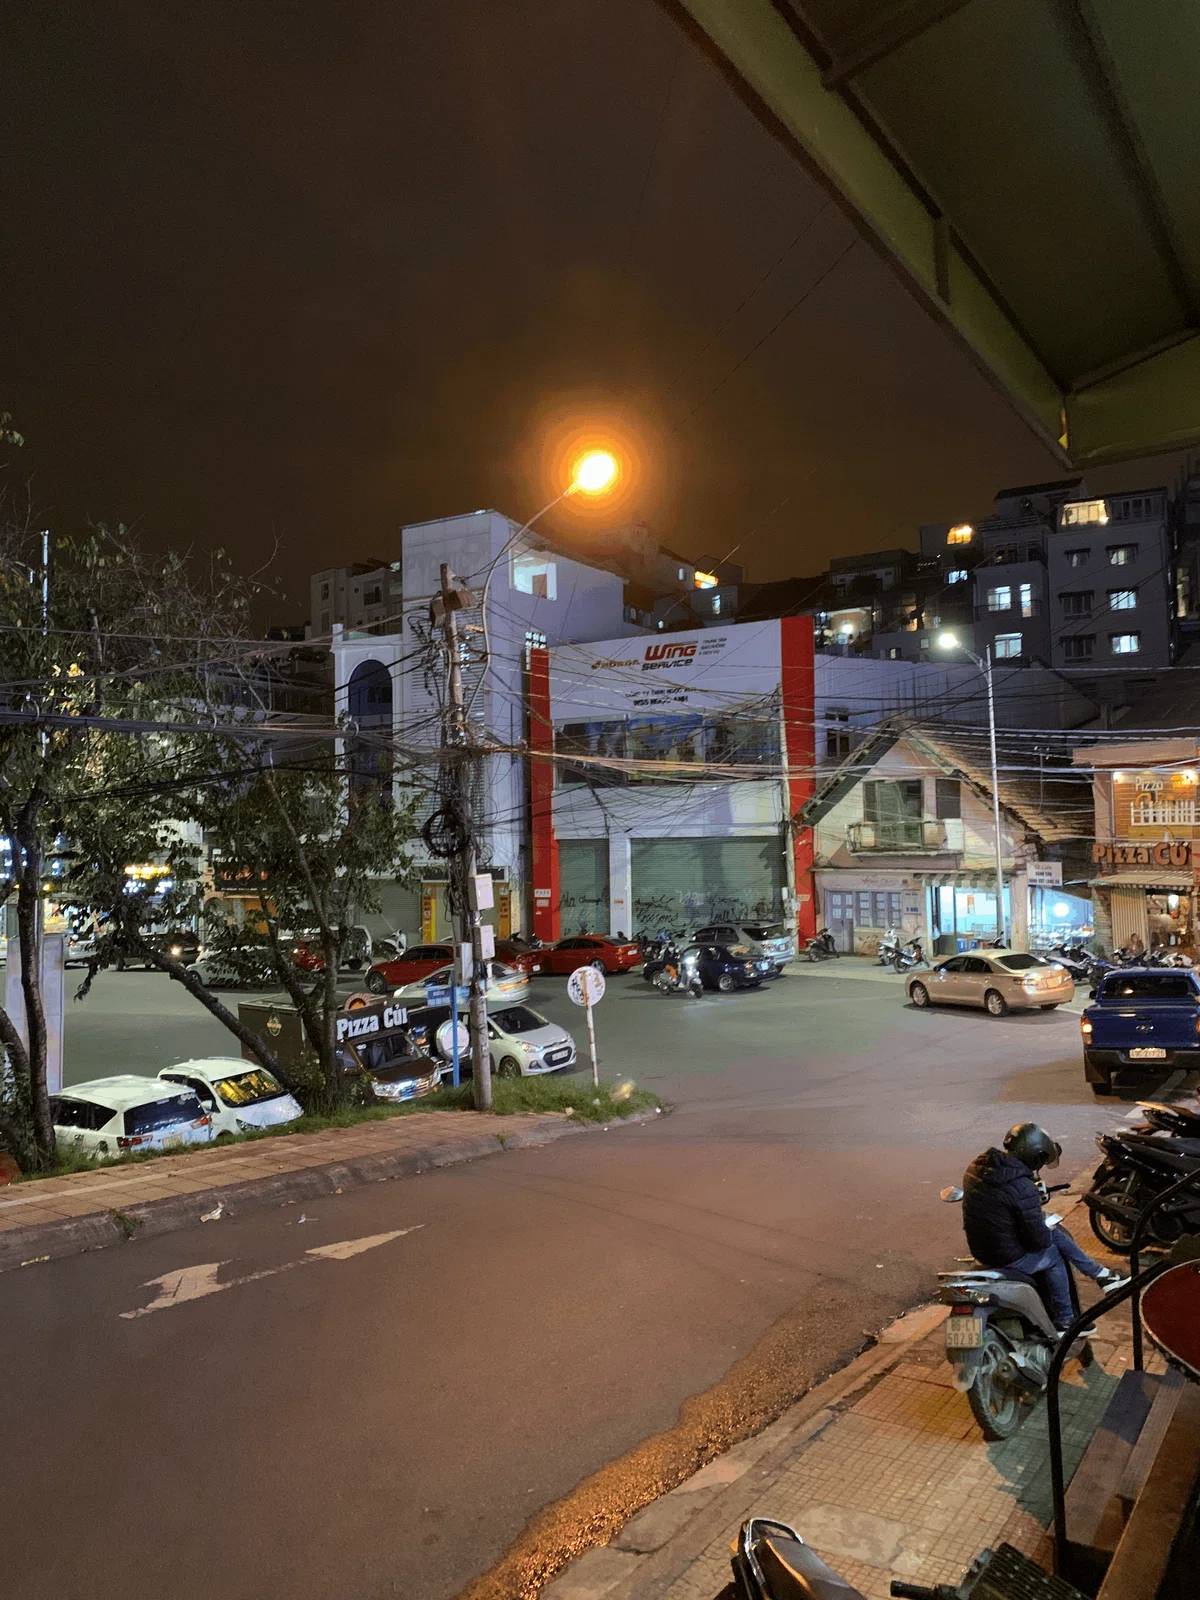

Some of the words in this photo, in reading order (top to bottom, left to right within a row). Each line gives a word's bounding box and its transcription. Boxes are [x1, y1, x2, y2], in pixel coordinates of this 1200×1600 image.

[1135, 776, 1163, 791] Pizza
[1093, 844, 1149, 864] Pizza
[337, 1015, 379, 1040] Pizza
